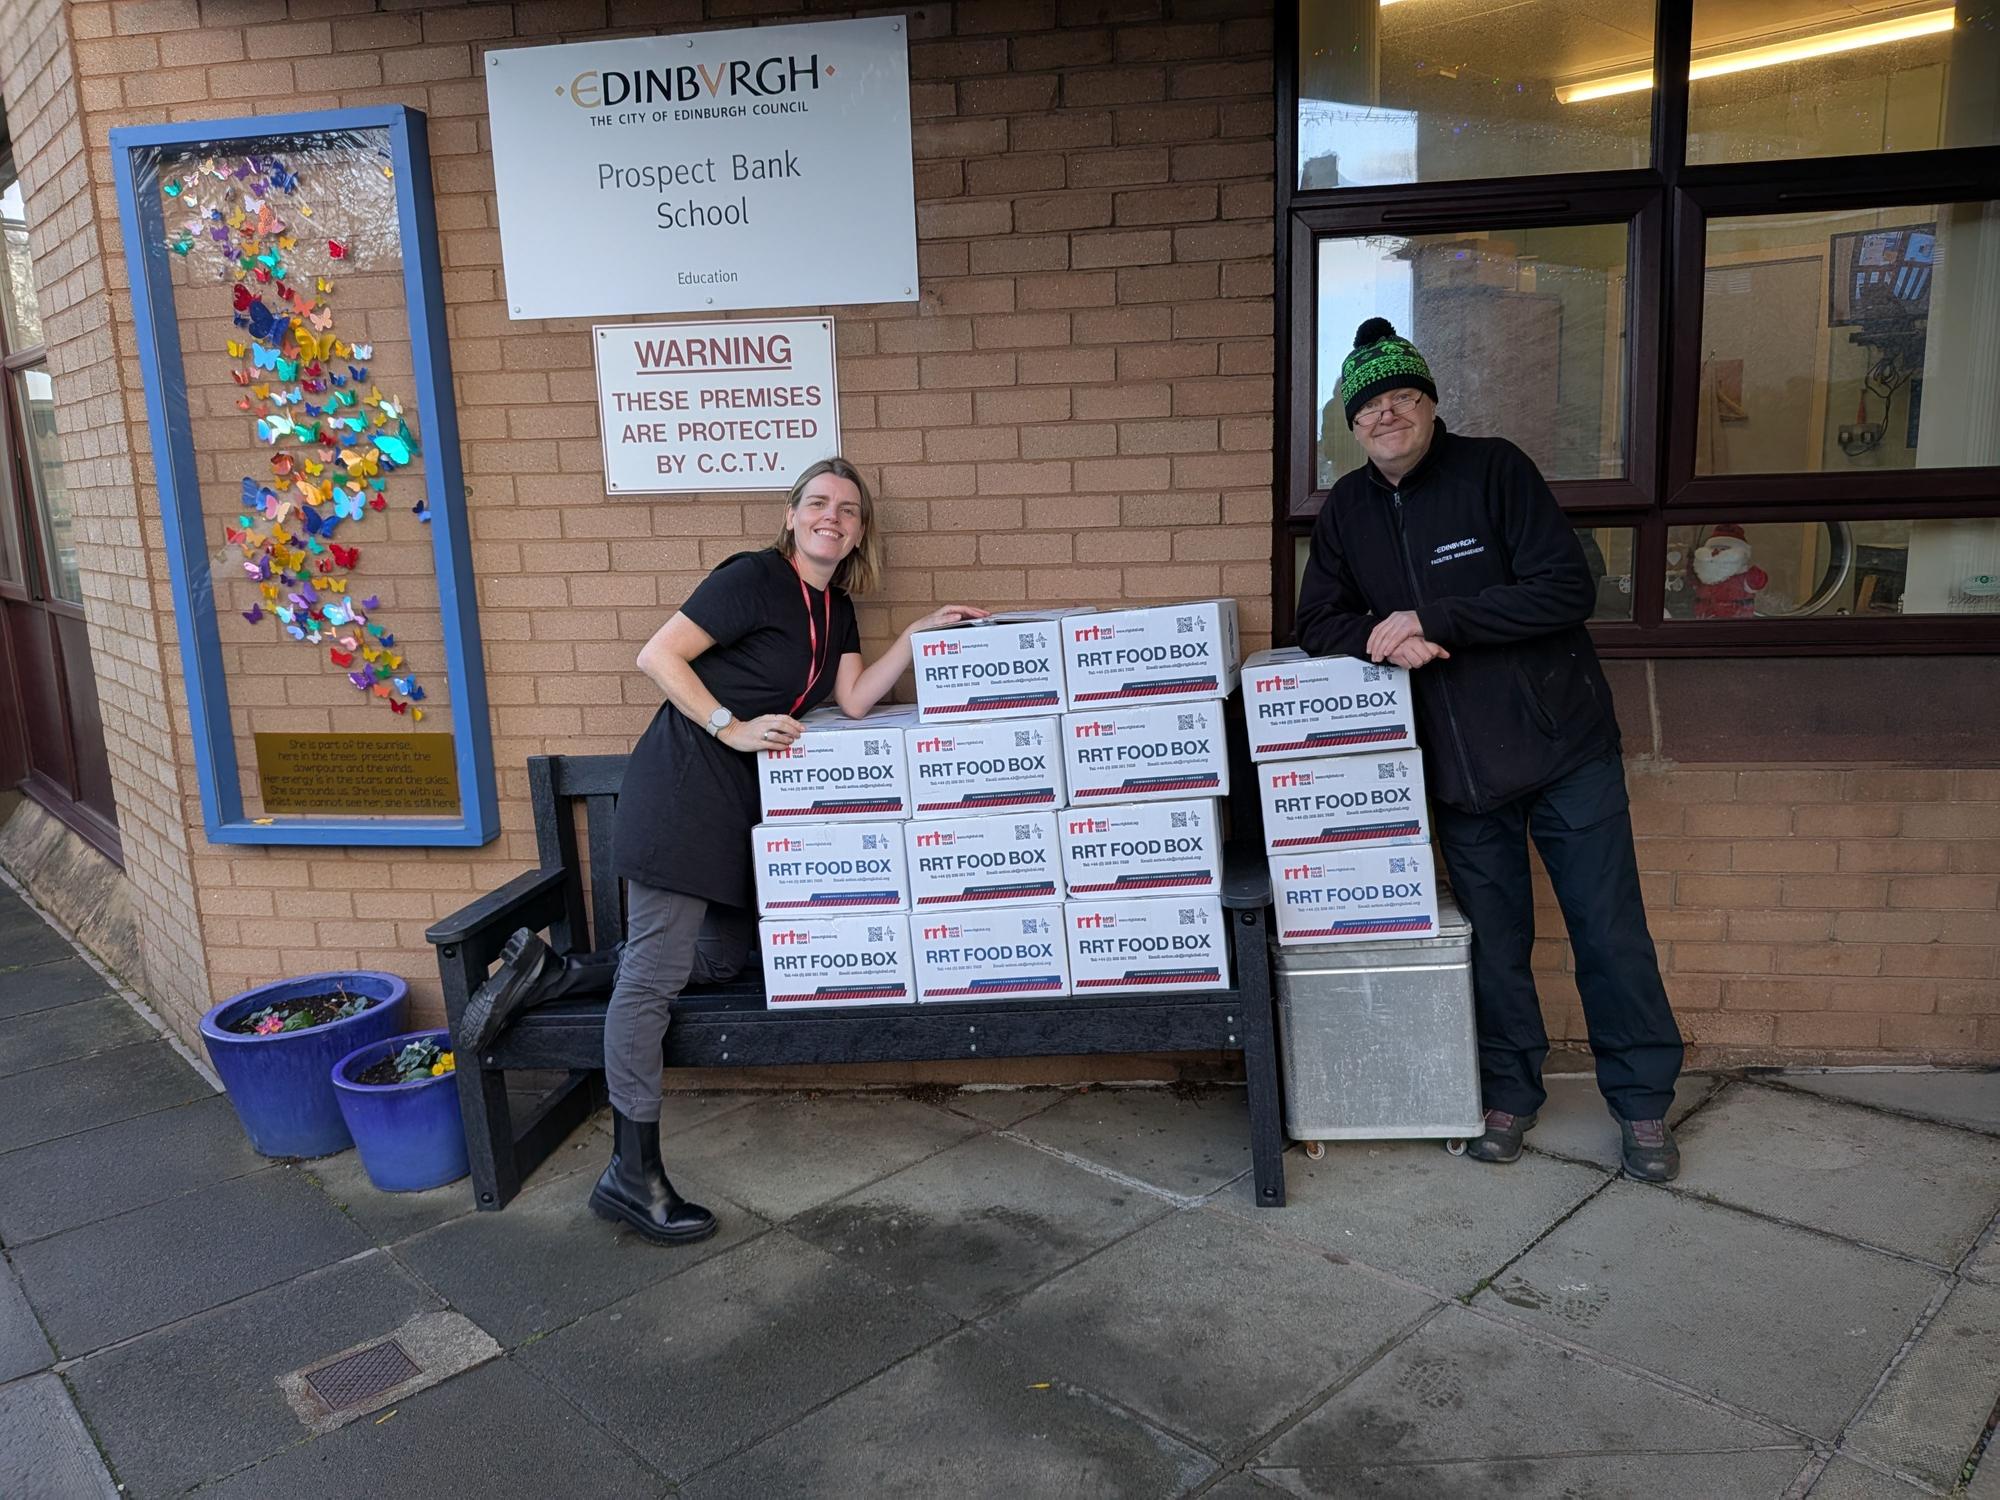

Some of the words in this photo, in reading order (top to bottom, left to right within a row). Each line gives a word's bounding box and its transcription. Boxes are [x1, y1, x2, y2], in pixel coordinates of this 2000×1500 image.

[590, 115, 615, 127] THE
[618, 112, 646, 125] CITY
[651, 110, 668, 122] OF
[674, 106, 747, 121] EDINBURGH
[752, 101, 808, 116] COUNCIL
[598, 157, 716, 192] Prospect
[732, 149, 801, 181] Bank
[657, 197, 749, 230] School
[677, 269, 738, 285] Education
[634, 334, 792, 368] WARNING
[612, 391, 689, 412] THESE
[700, 386, 821, 409] PREMISES
[622, 423, 667, 444] ARE
[678, 419, 817, 442] PROTECTED
[657, 455, 685, 474] BY
[697, 452, 785, 473] C.C.T.V.
[1075, 625, 1099, 642] rrt
[923, 641, 946, 656] rrt
[1077, 651, 1112, 668] RRT
[1116, 646, 1166, 664] FOOD
[1171, 642, 1209, 659] BOX
[926, 666, 958, 681] RRT
[962, 662, 1010, 678] FOOD
[1014, 658, 1050, 674] BOX
[1257, 676, 1281, 692] rrt
[1259, 701, 1295, 718] RRT
[1300, 696, 1352, 714] FOOD
[1356, 691, 1397, 708] BOX
[1076, 722, 1100, 737] rrt
[318, 741, 338, 750] part
[357, 740, 372, 749] the
[917, 737, 940, 752] rrt
[1078, 747, 1113, 763] RRT
[1117, 743, 1167, 760] FOOD
[1171, 739, 1210, 755] BOX
[312, 753, 328, 761] the
[414, 753, 431, 761] the
[347, 764, 363, 773] and
[368, 764, 383, 773] the
[770, 770, 803, 784] RRT
[807, 767, 854, 782] FOOD
[858, 765, 894, 779] BOX
[920, 763, 953, 778] RRT
[957, 759, 1005, 775] FOOD
[1008, 756, 1046, 771] BOX
[385, 776, 401, 784] and
[1272, 772, 1297, 787] rrt
[1275, 797, 1311, 813] RRT
[1316, 792, 1367, 809] FOOD
[1371, 788, 1411, 804] BOX
[1070, 818, 1094, 834] rrt
[767, 838, 790, 852] rrt
[917, 831, 940, 846] rrt
[1072, 844, 1106, 859] RRT
[1111, 840, 1161, 856] FOOD
[1165, 837, 1203, 853] BOX
[769, 863, 802, 876] RRT
[806, 861, 852, 875] FOOD
[856, 859, 891, 873] BOX
[920, 856, 953, 872] RRT
[957, 853, 1005, 869] FOOD
[1009, 849, 1046, 865] BOX
[1284, 865, 1309, 880] rrt
[1287, 890, 1322, 904] RRT
[1327, 886, 1378, 902] FOOD
[1382, 883, 1422, 898] BOX
[1077, 913, 1101, 928] rrt
[772, 930, 795, 945] rrt
[924, 925, 947, 939] rrt
[1080, 939, 1114, 954] RRT
[1118, 936, 1169, 952] FOOD
[1173, 934, 1211, 949] BOX
[774, 956, 807, 970] RRT
[811, 954, 858, 968] FOOD
[861, 952, 898, 966] BOX
[926, 949, 960, 963] RRT
[964, 946, 1012, 961] FOOD
[1016, 944, 1053, 958] BOX
